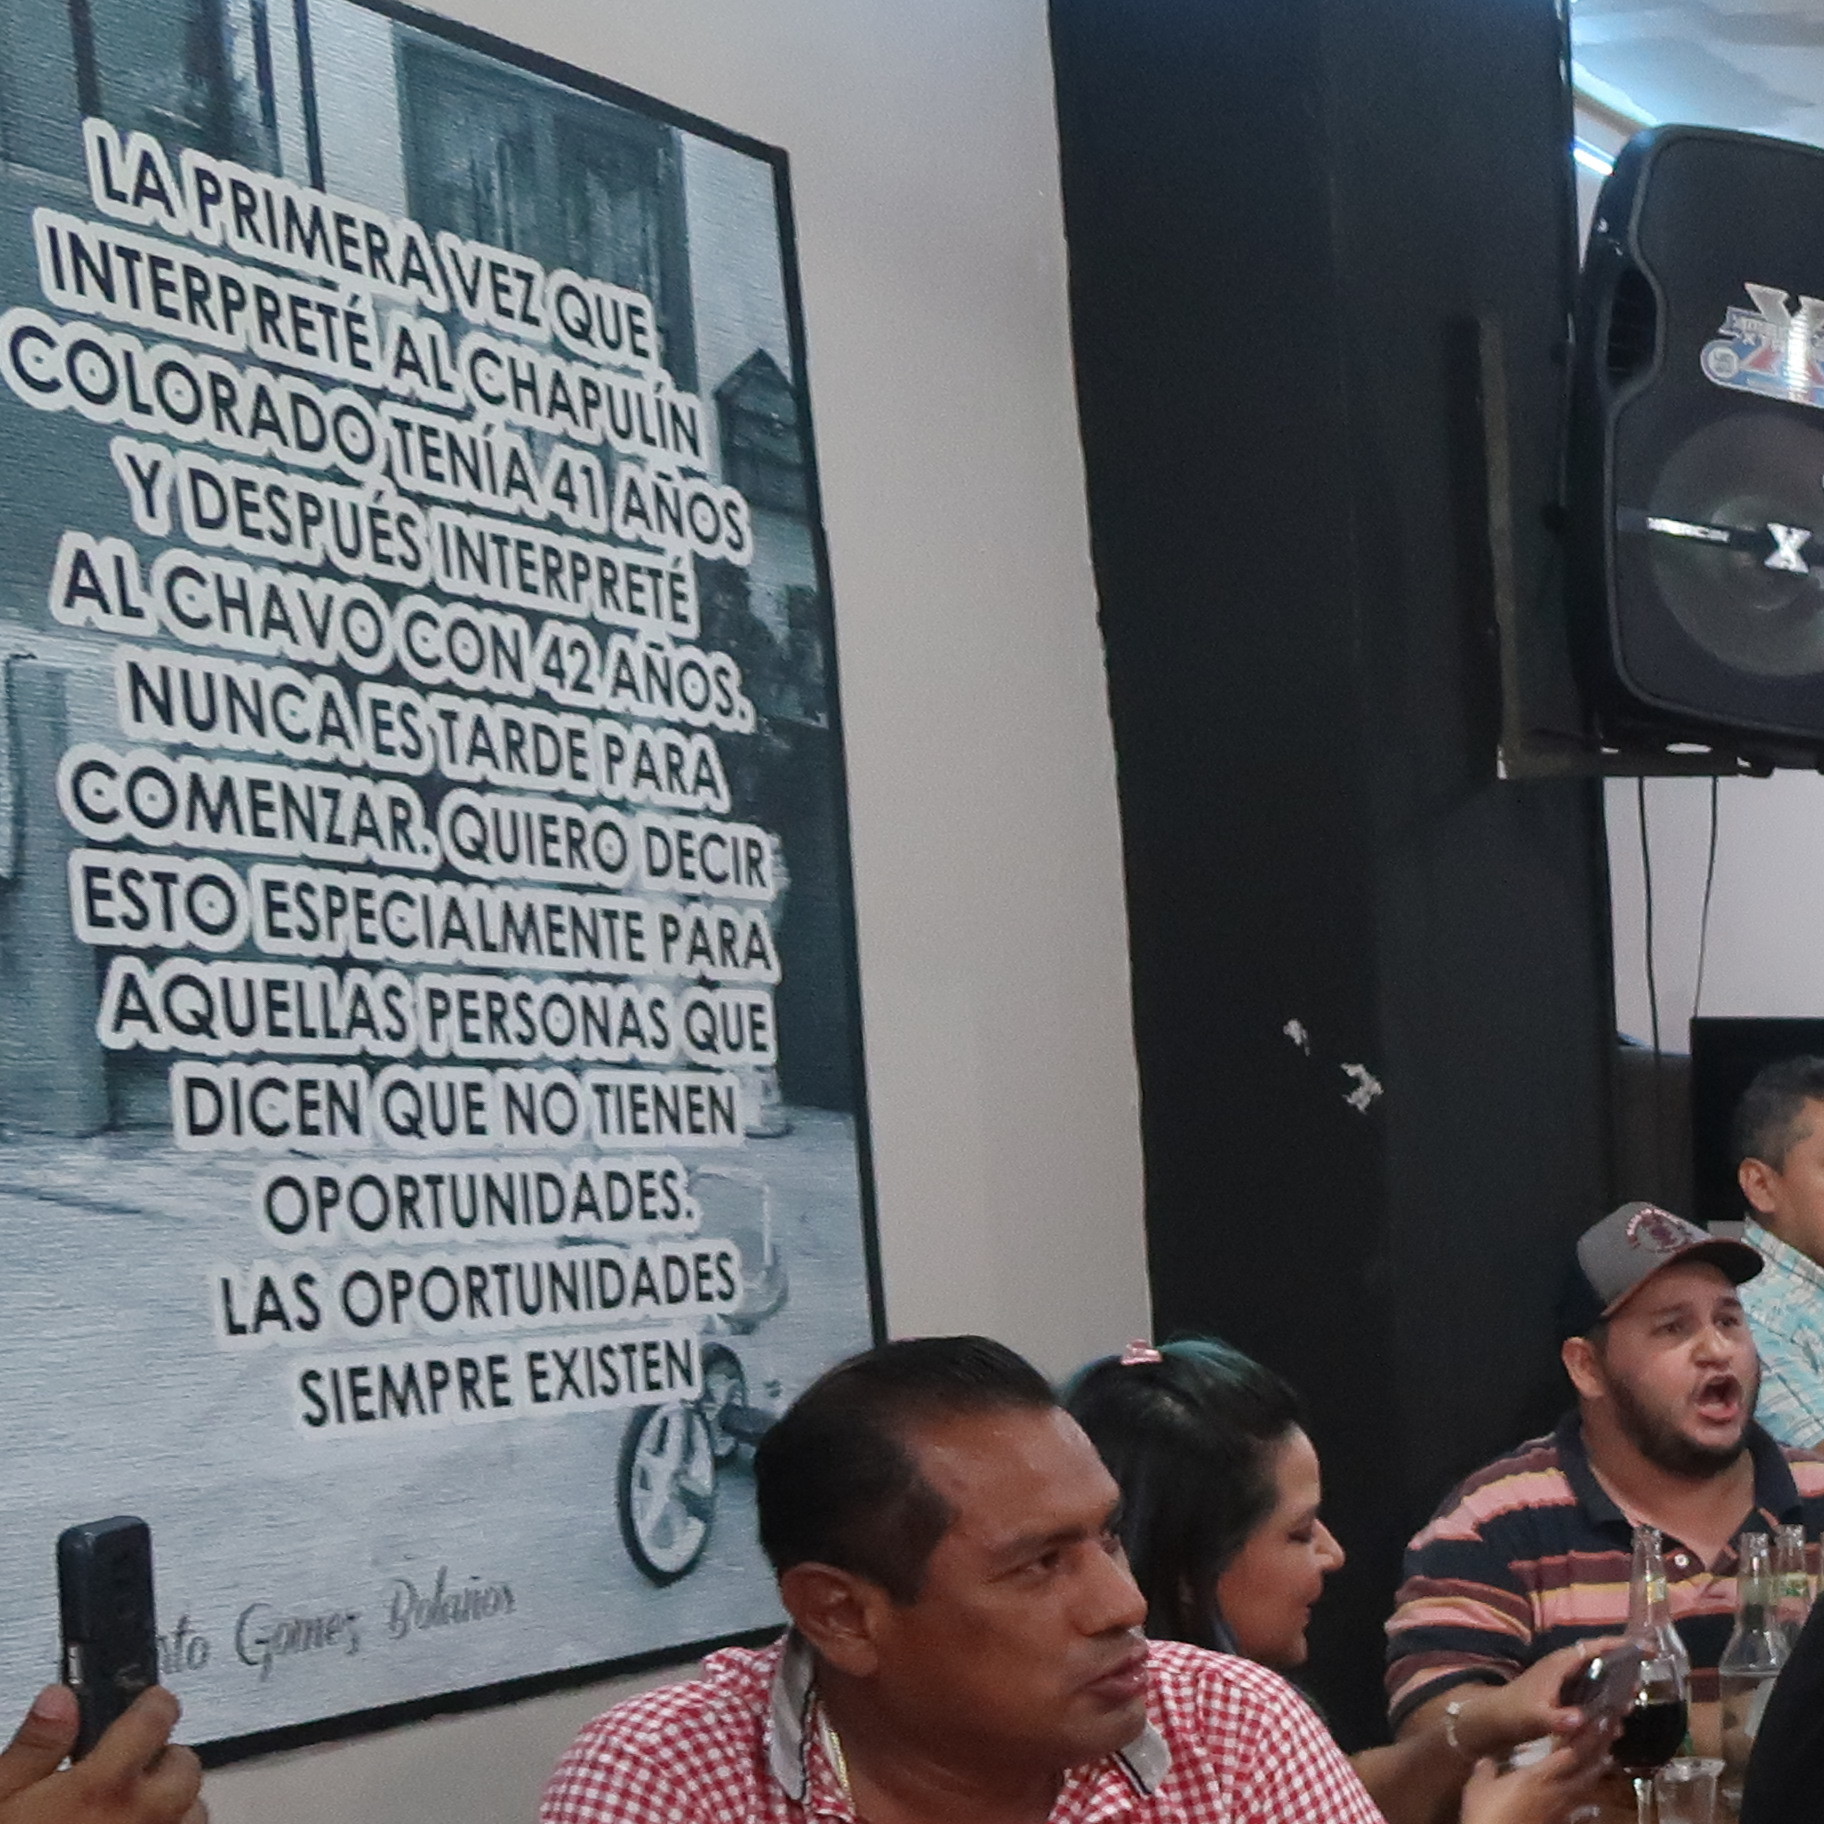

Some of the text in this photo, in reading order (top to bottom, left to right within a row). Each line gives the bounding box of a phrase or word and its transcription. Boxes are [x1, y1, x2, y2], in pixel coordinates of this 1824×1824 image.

[96, 134, 651, 358] LA PRIMERA VEZ QUE
[47, 226, 702, 458] INTERPRETÉ AL CHAPULÍN
[9, 325, 745, 551] COLORADO TENÍA 41 AÑOS
[126, 454, 691, 625] Y DESPUÉS INTERPRETÉ
[64, 549, 748, 721] AL CHAVO CON 42 AÑOS.
[127, 661, 720, 799] NUNCA ES TARDE PARA
[71, 759, 767, 888] COMENZAR. QUIERO DECIR
[82, 865, 772, 971] ESTO ESPECIALMENTE PARA
[112, 972, 768, 1053] AQUELLAS PERSONAS QUE
[184, 1076, 737, 1140] DICEN QUE NO TIENEN
[263, 1168, 694, 1236] OPORTUNIDADES.
[222, 1250, 737, 1336] LAS OPORTUNIDADES
[300, 1337, 697, 1429] SIEMPRE EXISTEN
